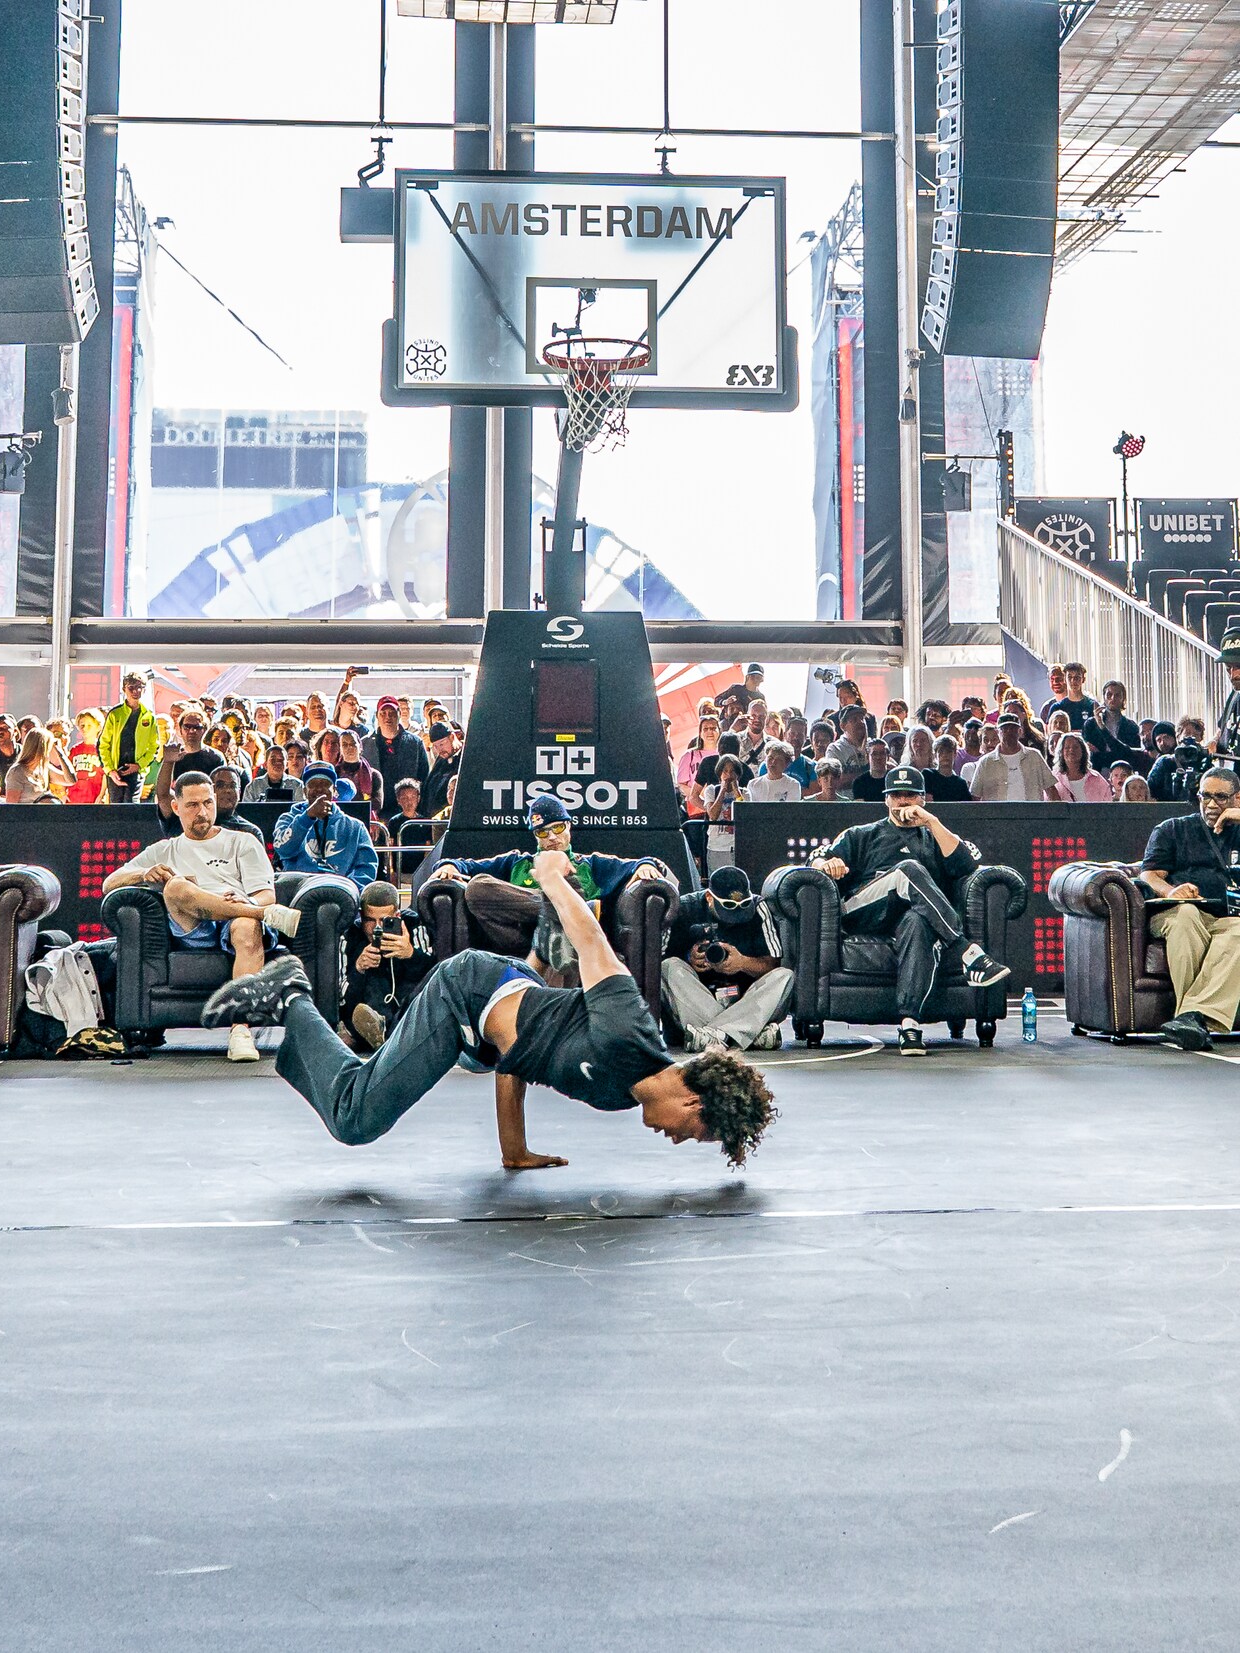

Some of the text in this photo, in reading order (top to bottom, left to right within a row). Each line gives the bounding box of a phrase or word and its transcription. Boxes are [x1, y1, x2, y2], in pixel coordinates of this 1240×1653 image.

[452, 202, 733, 239] AMSTERDAM
[1045, 514, 1083, 527] UNITES
[1149, 514, 1224, 532] UNIBET
[482, 780, 648, 810] TISSOT
[482, 815, 519, 825] SWISS
[583, 815, 618, 825] SINCE
[621, 815, 648, 825] 1853
